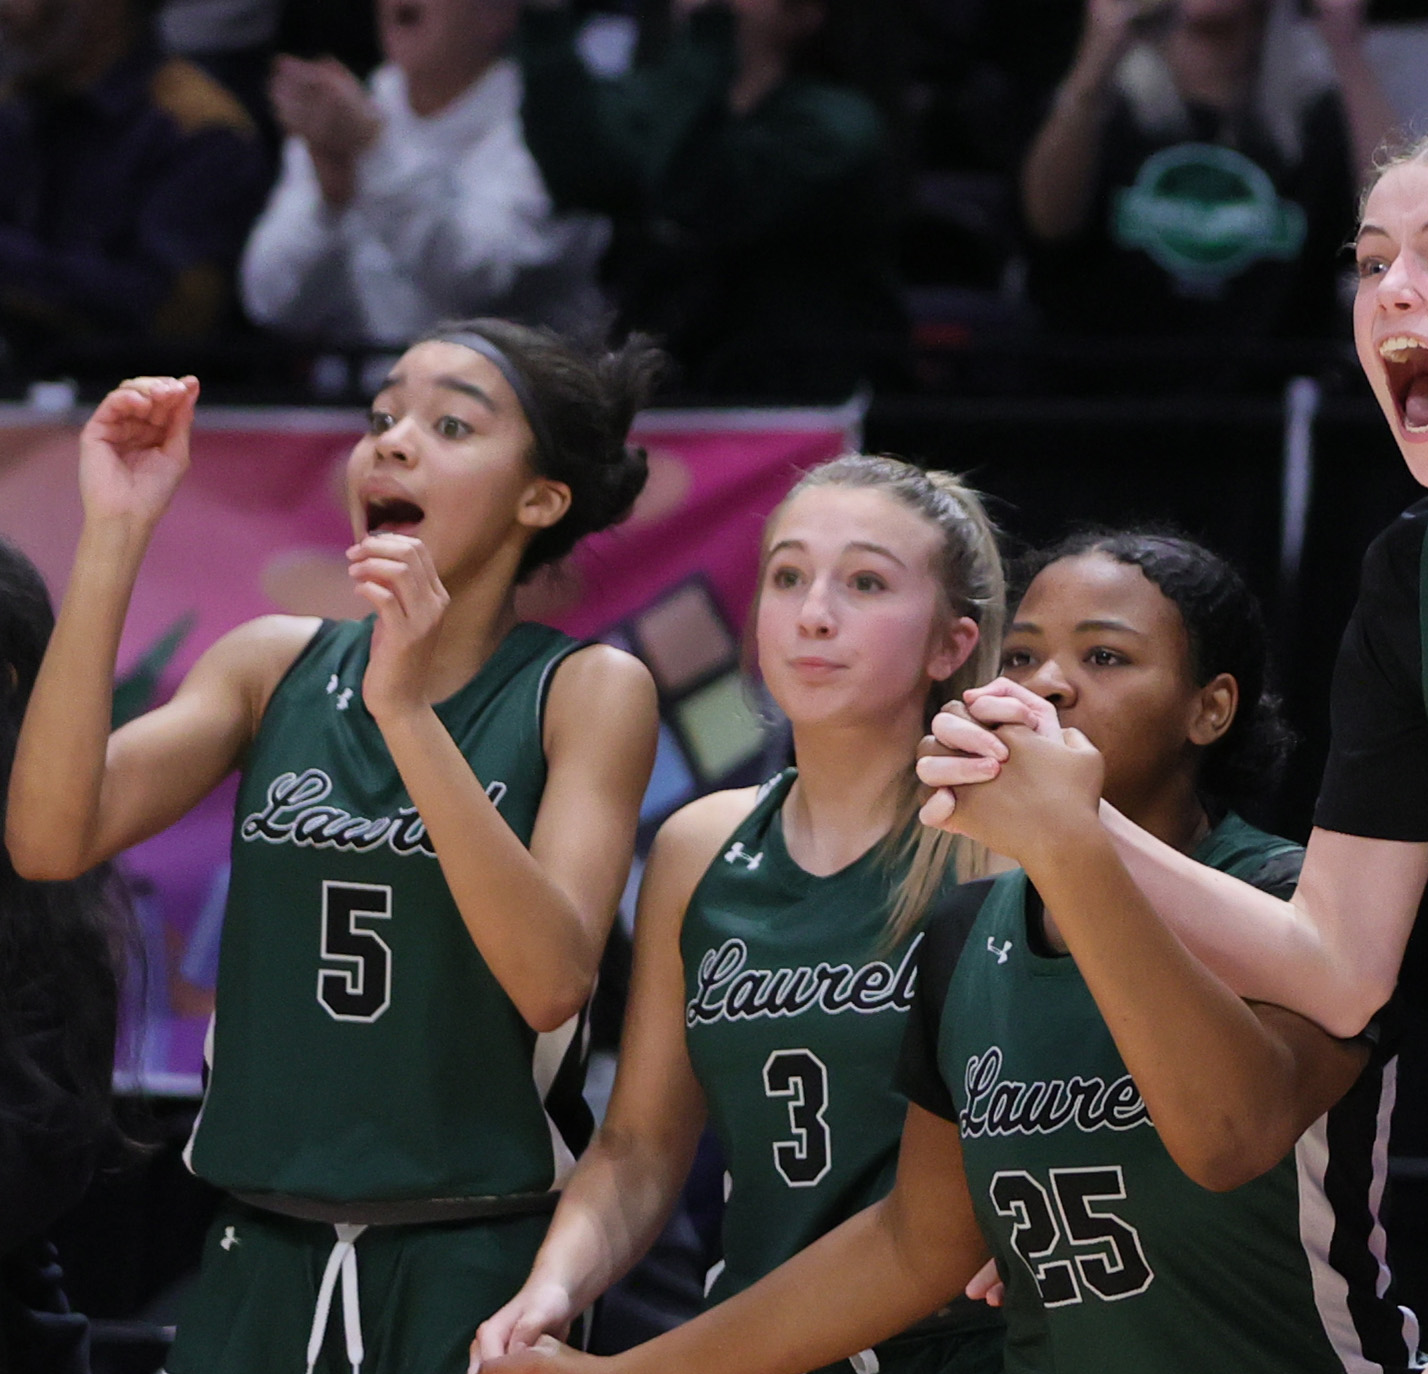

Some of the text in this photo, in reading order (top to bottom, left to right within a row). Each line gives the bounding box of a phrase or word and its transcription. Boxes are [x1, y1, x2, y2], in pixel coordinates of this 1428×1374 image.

[317, 880, 392, 1023] 5
[763, 1048, 831, 1187] 3
[961, 1046, 1156, 1138] Laure
[989, 1166, 1154, 1307] 25
